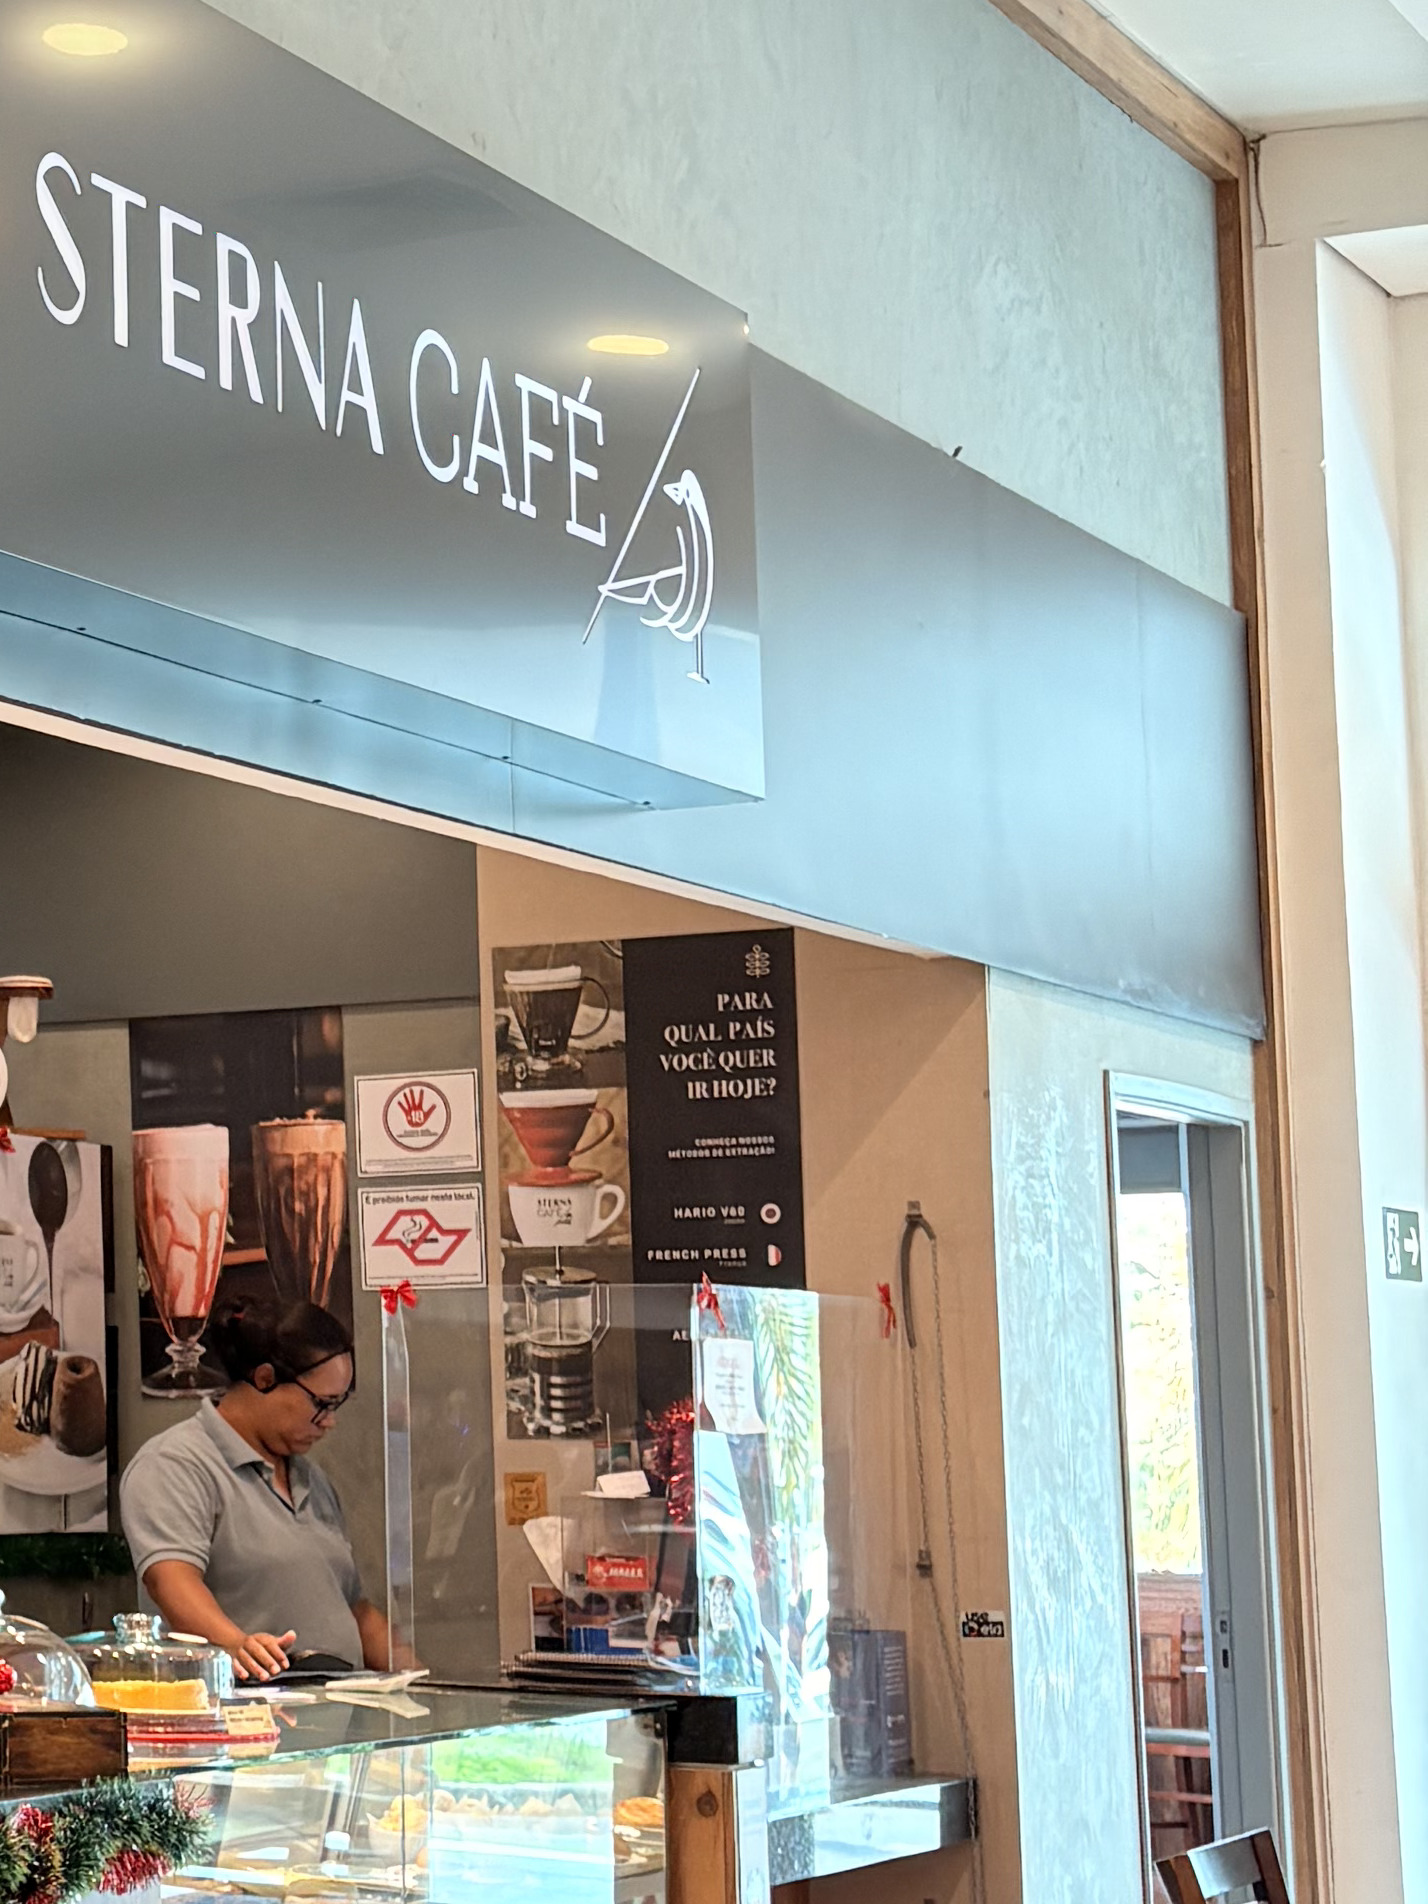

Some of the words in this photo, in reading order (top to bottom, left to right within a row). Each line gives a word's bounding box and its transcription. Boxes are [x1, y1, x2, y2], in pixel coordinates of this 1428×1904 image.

[35, 151, 385, 457] STERNA
[409, 375, 607, 548] CAFÉ
[716, 991, 774, 1012] PARA
[663, 1022, 723, 1047] QUAL
[728, 1015, 776, 1040] PAÍS
[718, 1048, 777, 1074] QUER
[687, 1081, 710, 1100] IR
[712, 1076, 777, 1100] HOJE?
[667, 1148, 711, 1159] MÉTODOS
[712, 1147, 724, 1158] DE
[405, 1194, 429, 1203] fumar
[673, 1206, 716, 1219] HARIO
[647, 1249, 700, 1261] FRENCH
[703, 1247, 747, 1260] PRESS
